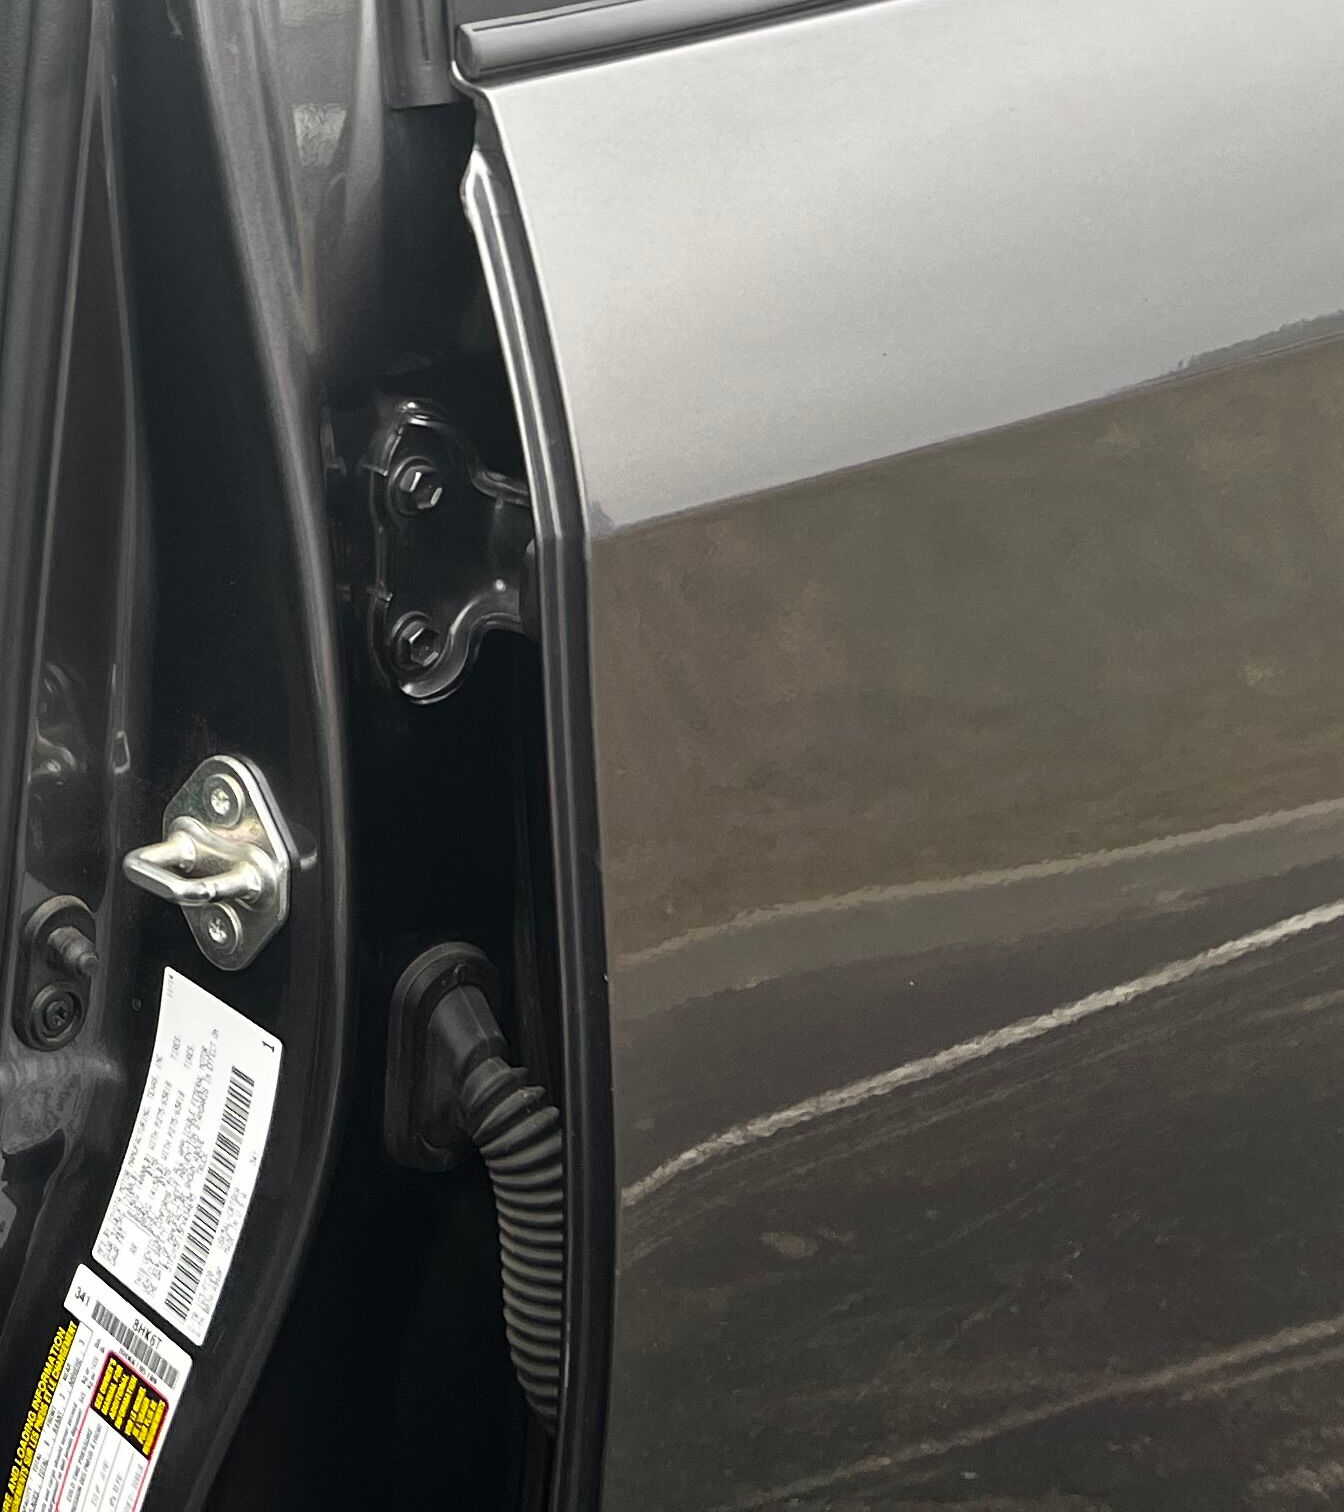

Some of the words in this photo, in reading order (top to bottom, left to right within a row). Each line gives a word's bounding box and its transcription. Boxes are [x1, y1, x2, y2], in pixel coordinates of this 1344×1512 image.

[74, 1285, 91, 1306] 341
[7, 1464, 20, 1493] AND
[14, 1409, 36, 1465] LOADING
[30, 1326, 66, 1410] INFORMATION
